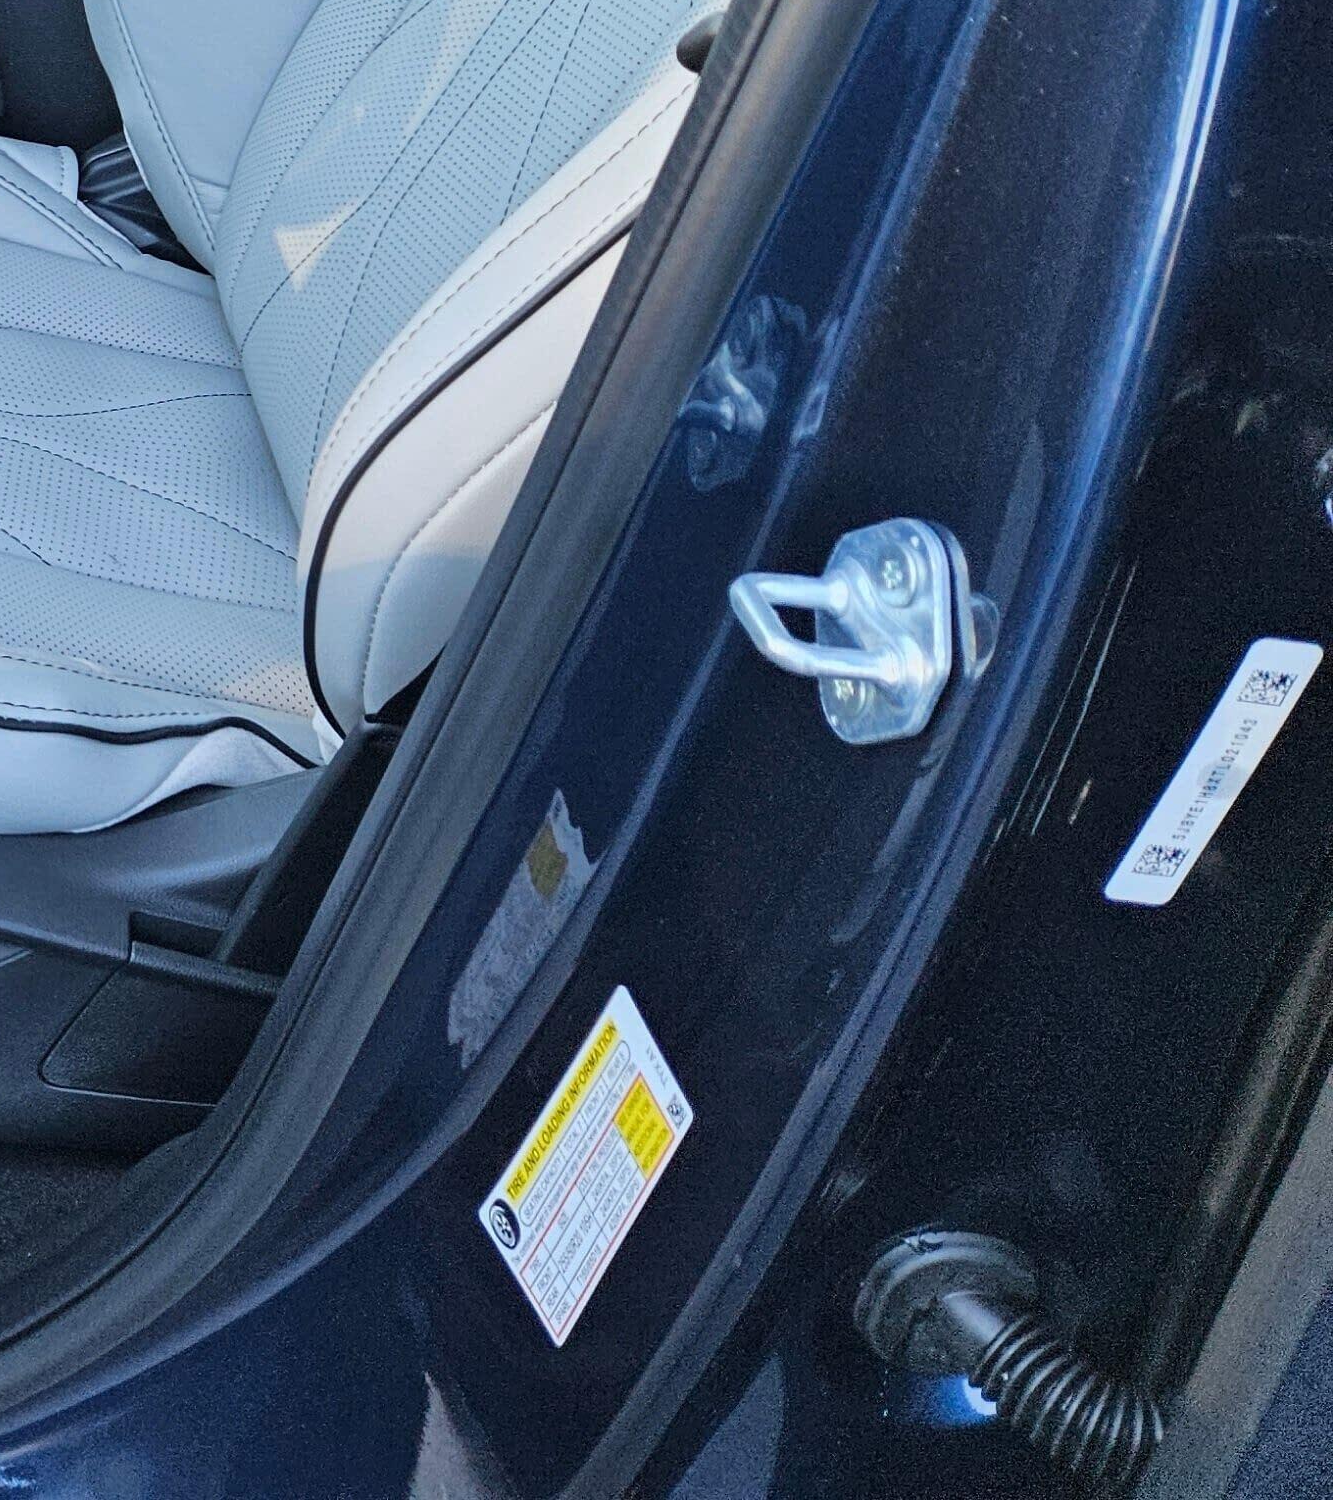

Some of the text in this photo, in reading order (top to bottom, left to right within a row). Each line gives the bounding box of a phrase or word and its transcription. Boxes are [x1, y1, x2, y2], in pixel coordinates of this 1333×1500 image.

[506, 1169, 526, 1201] TIRE
[522, 1146, 540, 1176] AND
[537, 1096, 571, 1153] LOADING
[566, 1020, 617, 1104] INFORMATION
[522, 1184, 544, 1220] SEATING
[536, 1264, 553, 1294] FRONT
